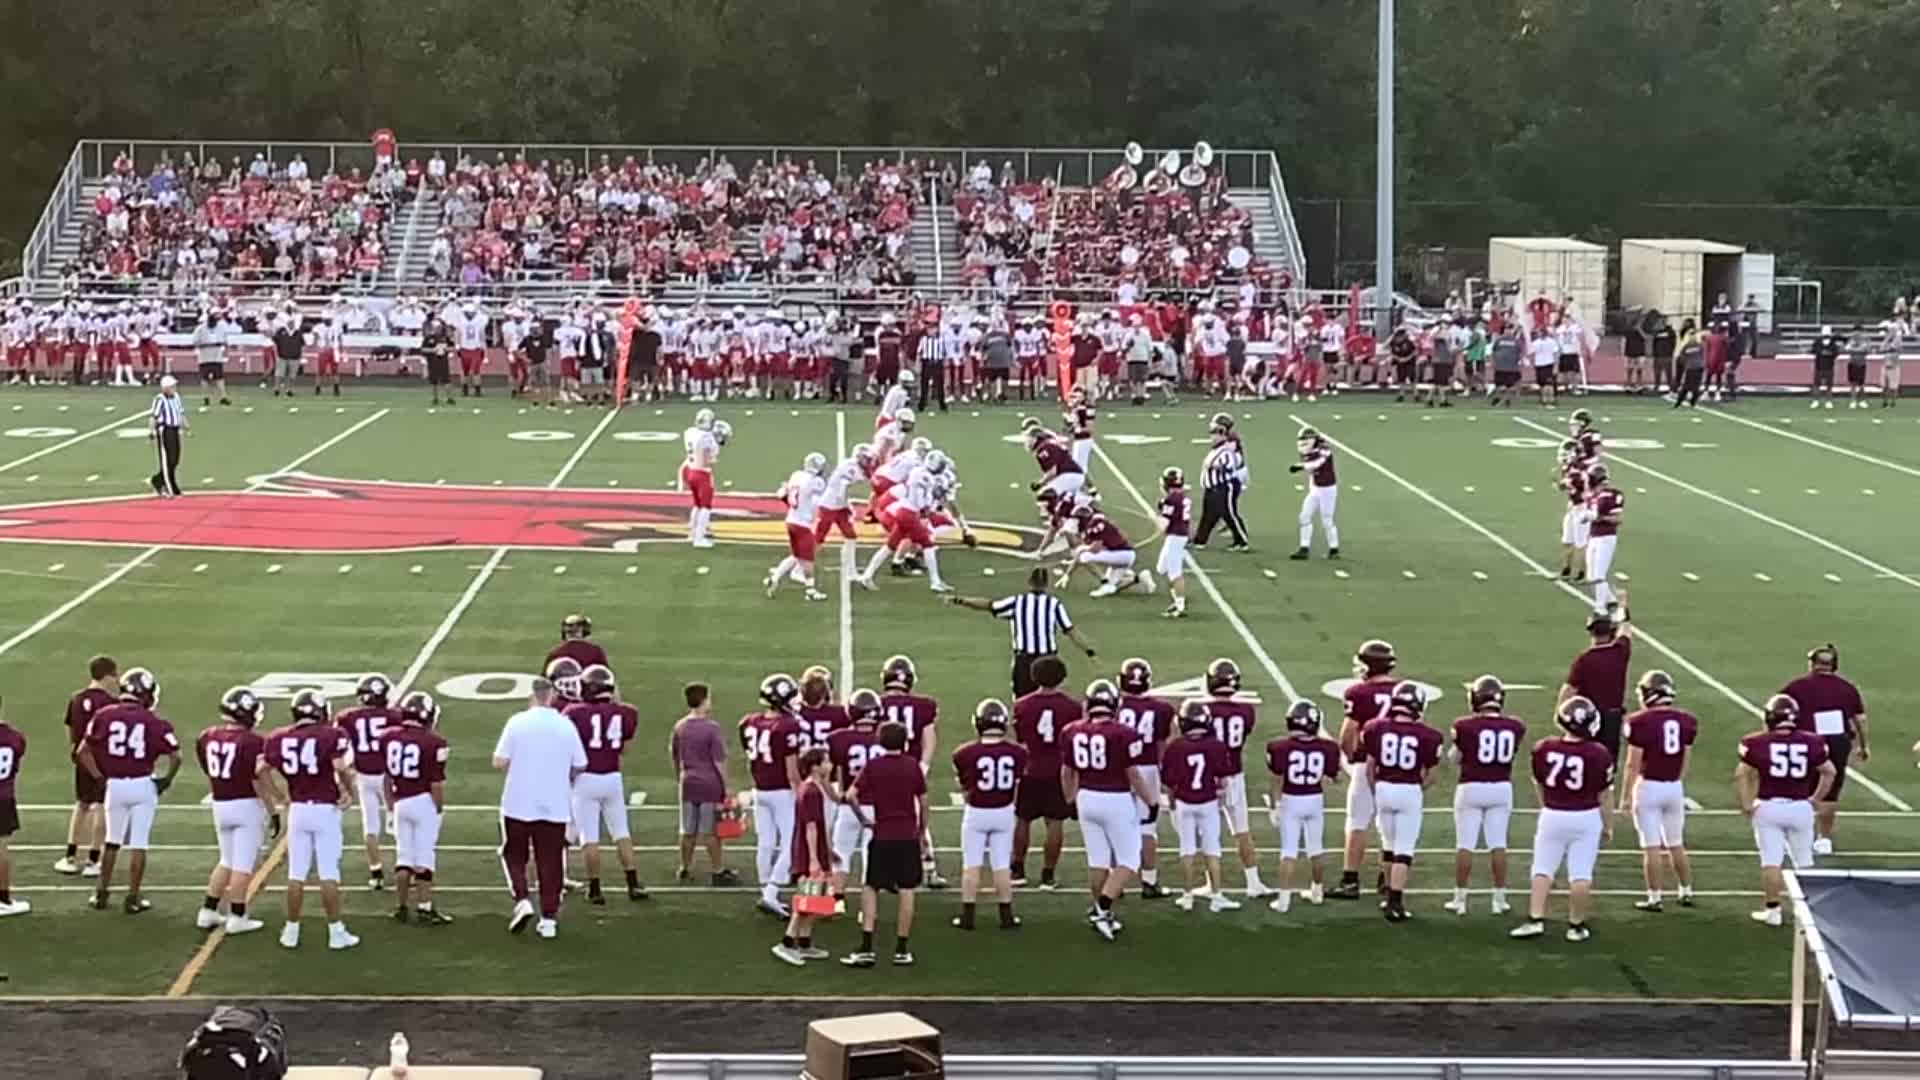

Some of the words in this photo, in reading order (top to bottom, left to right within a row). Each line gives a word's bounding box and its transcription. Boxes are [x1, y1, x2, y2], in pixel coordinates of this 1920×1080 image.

[108, 721, 146, 759] 24
[355, 717, 386, 751] 15
[589, 714, 623, 748] 14
[1037, 709, 1054, 743] 4
[1213, 716, 1244, 748] 18
[1663, 720, 1681, 755] 8
[206, 741, 237, 779] 67
[280, 737, 319, 775] 54
[387, 741, 420, 778] 82
[744, 726, 773, 764] 34
[1072, 733, 1107, 770] 68
[1380, 732, 1419, 770] 86
[1477, 729, 1516, 763] 80
[1768, 743, 1809, 777] 55
[977, 755, 1015, 791] 36
[1187, 753, 1206, 790] 7
[1288, 750, 1325, 785] 29
[1546, 752, 1584, 790] 73
